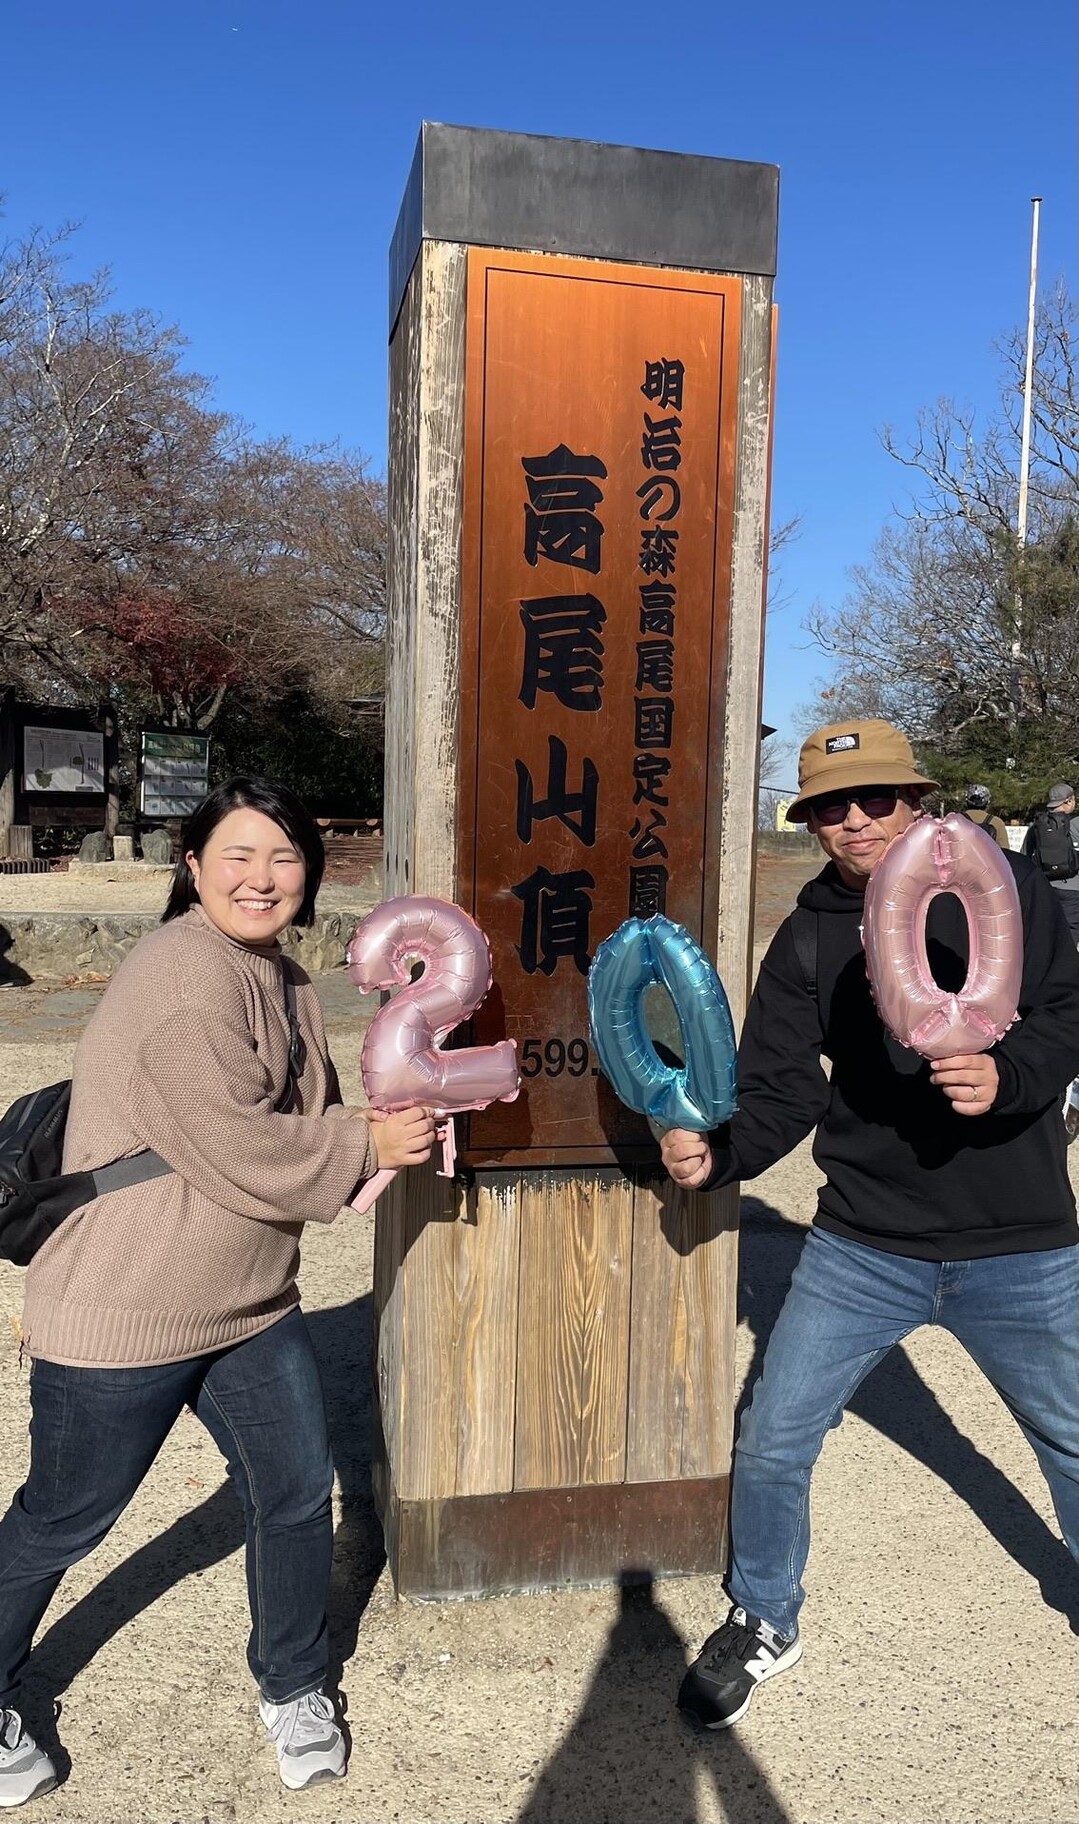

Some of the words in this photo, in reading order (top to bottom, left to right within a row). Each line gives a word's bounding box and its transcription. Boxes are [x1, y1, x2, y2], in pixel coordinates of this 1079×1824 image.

[511, 443, 608, 977] 高尾山頂
[628, 357, 685, 918] 明治の森高尾国定公園
